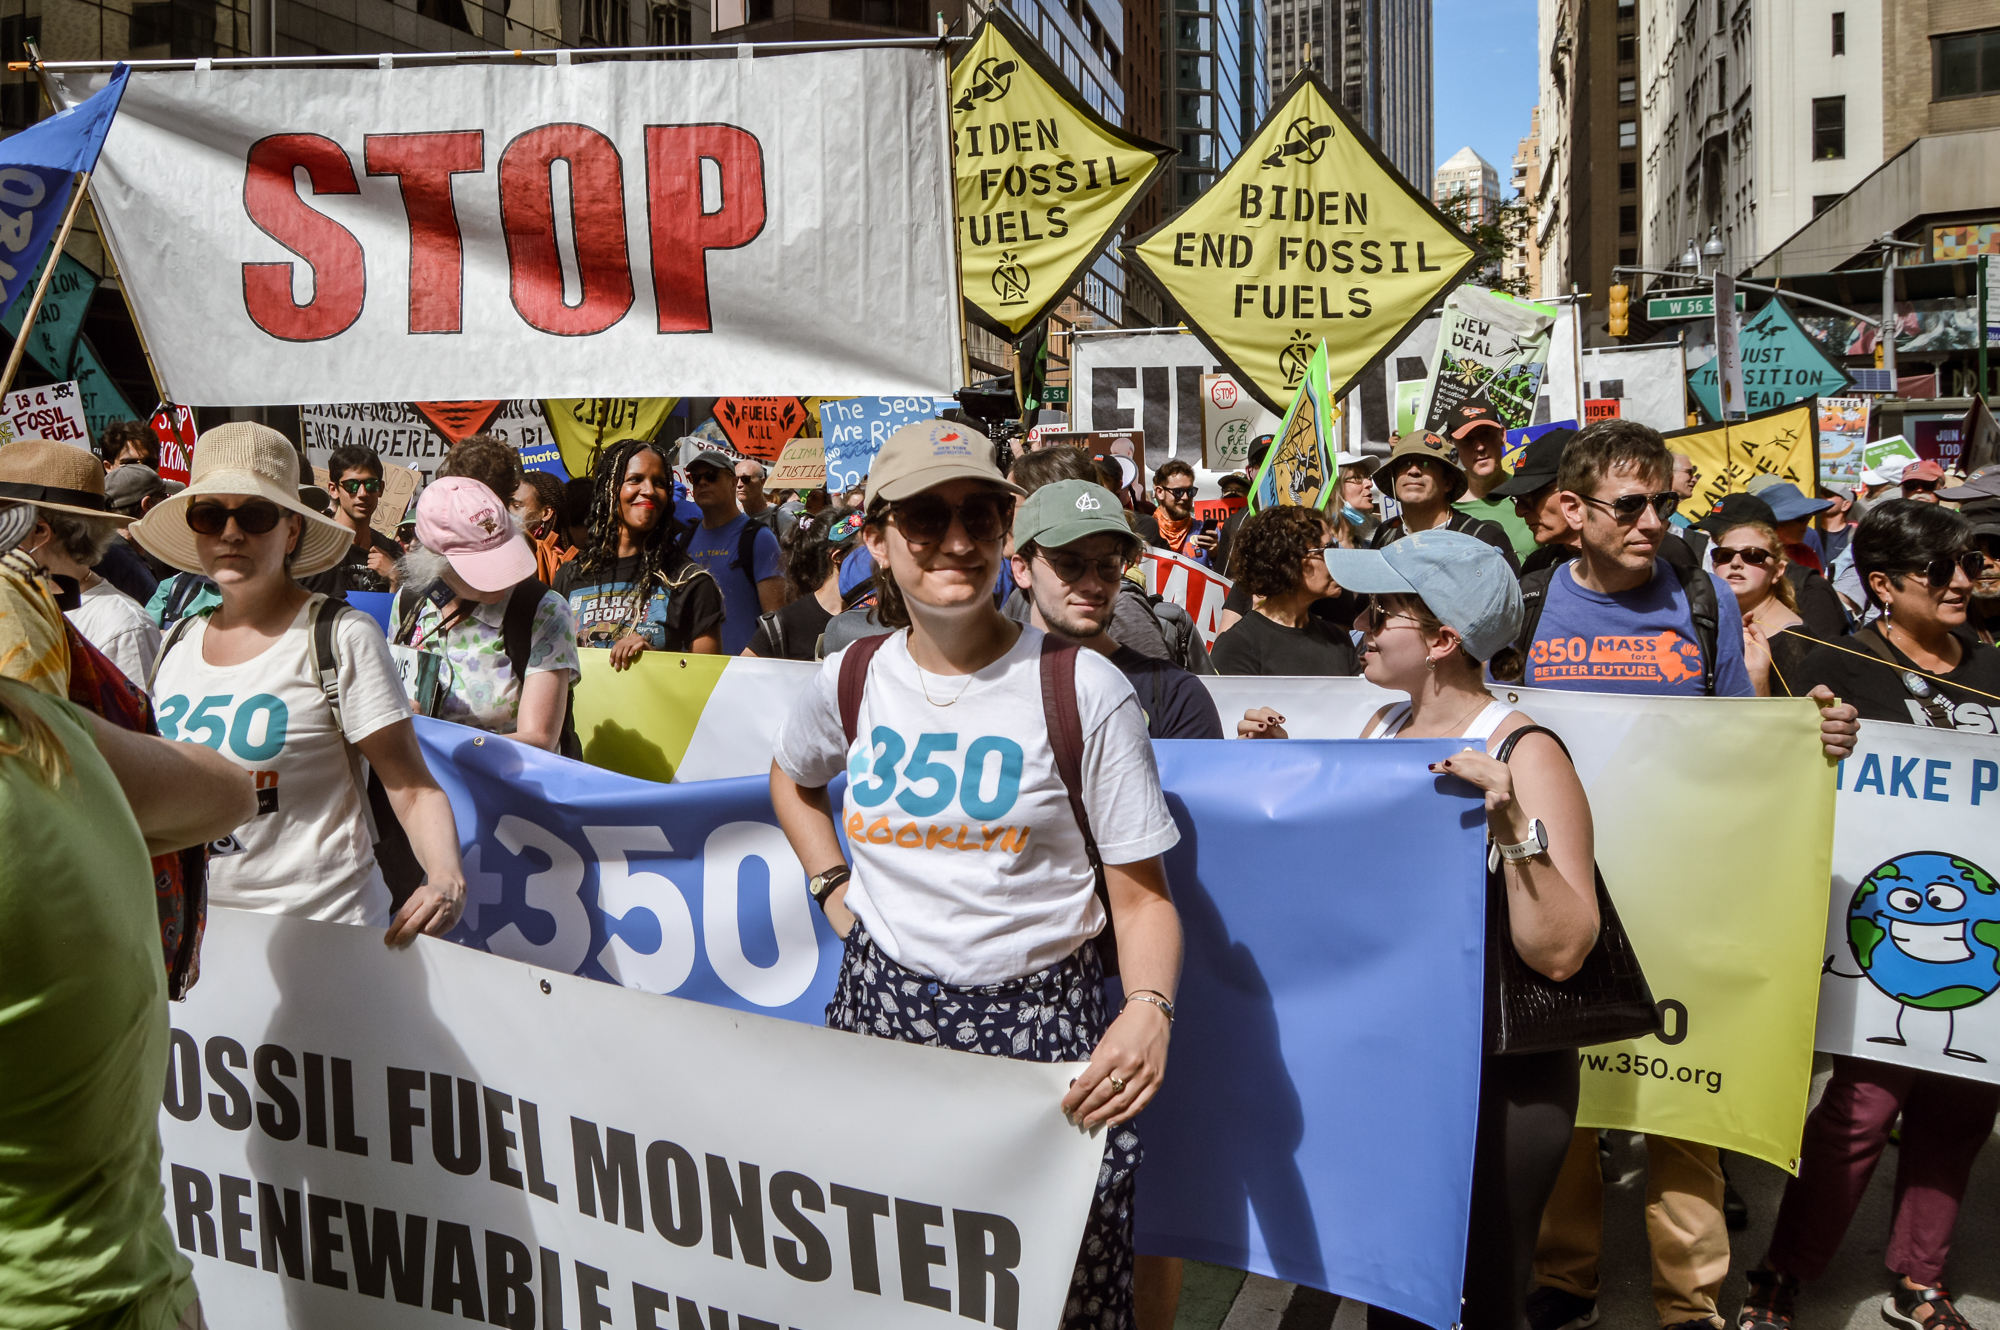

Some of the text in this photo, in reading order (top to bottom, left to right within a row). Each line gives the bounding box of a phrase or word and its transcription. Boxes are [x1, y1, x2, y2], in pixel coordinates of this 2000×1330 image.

[980, 156, 1130, 201] FOSSIL
[1240, 183, 1367, 225] BIDEN
[242, 122, 768, 343] STOP
[955, 207, 1068, 246] UELS
[1173, 232, 1441, 274] END FOSSIL
[1234, 284, 1372, 319] FUELS
[1670, 301, 1682, 314] W
[1687, 300, 1703, 313] 56
[1452, 333, 1493, 357] DEAL
[1741, 347, 1785, 363] JUST
[1704, 369, 1823, 386] TRSITION
[15, 394, 31, 410] is
[35, 392, 48, 406] a
[1053, 390, 1064, 399] St
[1216, 388, 1234, 401] STOP
[1744, 390, 1785, 407] EAD
[12, 406, 73, 436] FOSSIL
[159, 407, 188, 432] SP
[741, 405, 777, 421] FUELS
[821, 396, 932, 422] The Seas
[40, 419, 84, 441] FUEL
[748, 425, 772, 439] KILL
[831, 424, 863, 443] Are
[1227, 434, 1249, 446] FUEL
[1939, 443, 1962, 456] TOD
[828, 460, 860, 493] So
[586, 595, 651, 612] BLAC
[583, 606, 647, 626] PEOPL
[1534, 637, 1657, 664] 350 MASS
[1631, 653, 1648, 661] for
[1534, 665, 1657, 677] BETTER FUTURE
[157, 693, 289, 762] 350
[852, 725, 1024, 821] 350
[1837, 752, 1952, 803] AKE
[486, 814, 820, 1007] 350
[386, 1066, 559, 1205] FUEL
[569, 1115, 1022, 1330] MONSTER
[170, 1162, 615, 1330] RENEWABLE
